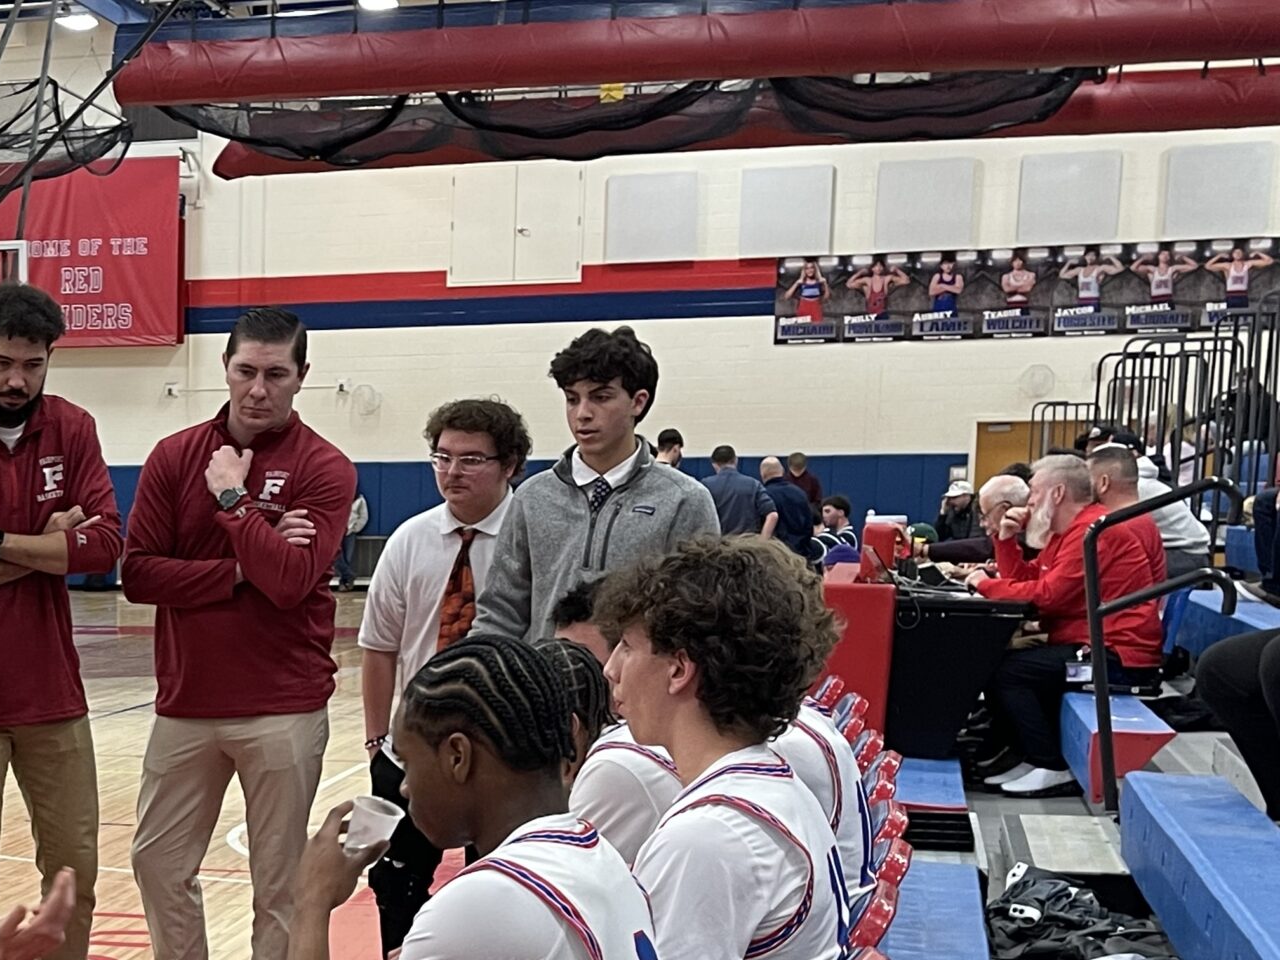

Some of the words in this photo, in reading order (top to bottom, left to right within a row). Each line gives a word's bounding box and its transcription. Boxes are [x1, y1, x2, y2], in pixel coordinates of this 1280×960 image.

[28, 239, 71, 257] OME
[78, 238, 103, 256] OF
[110, 237, 148, 255] THE
[60, 266, 103, 294] RED
[62, 303, 133, 330] IDERS
[42, 463, 64, 491] F
[259, 479, 286, 500] F
